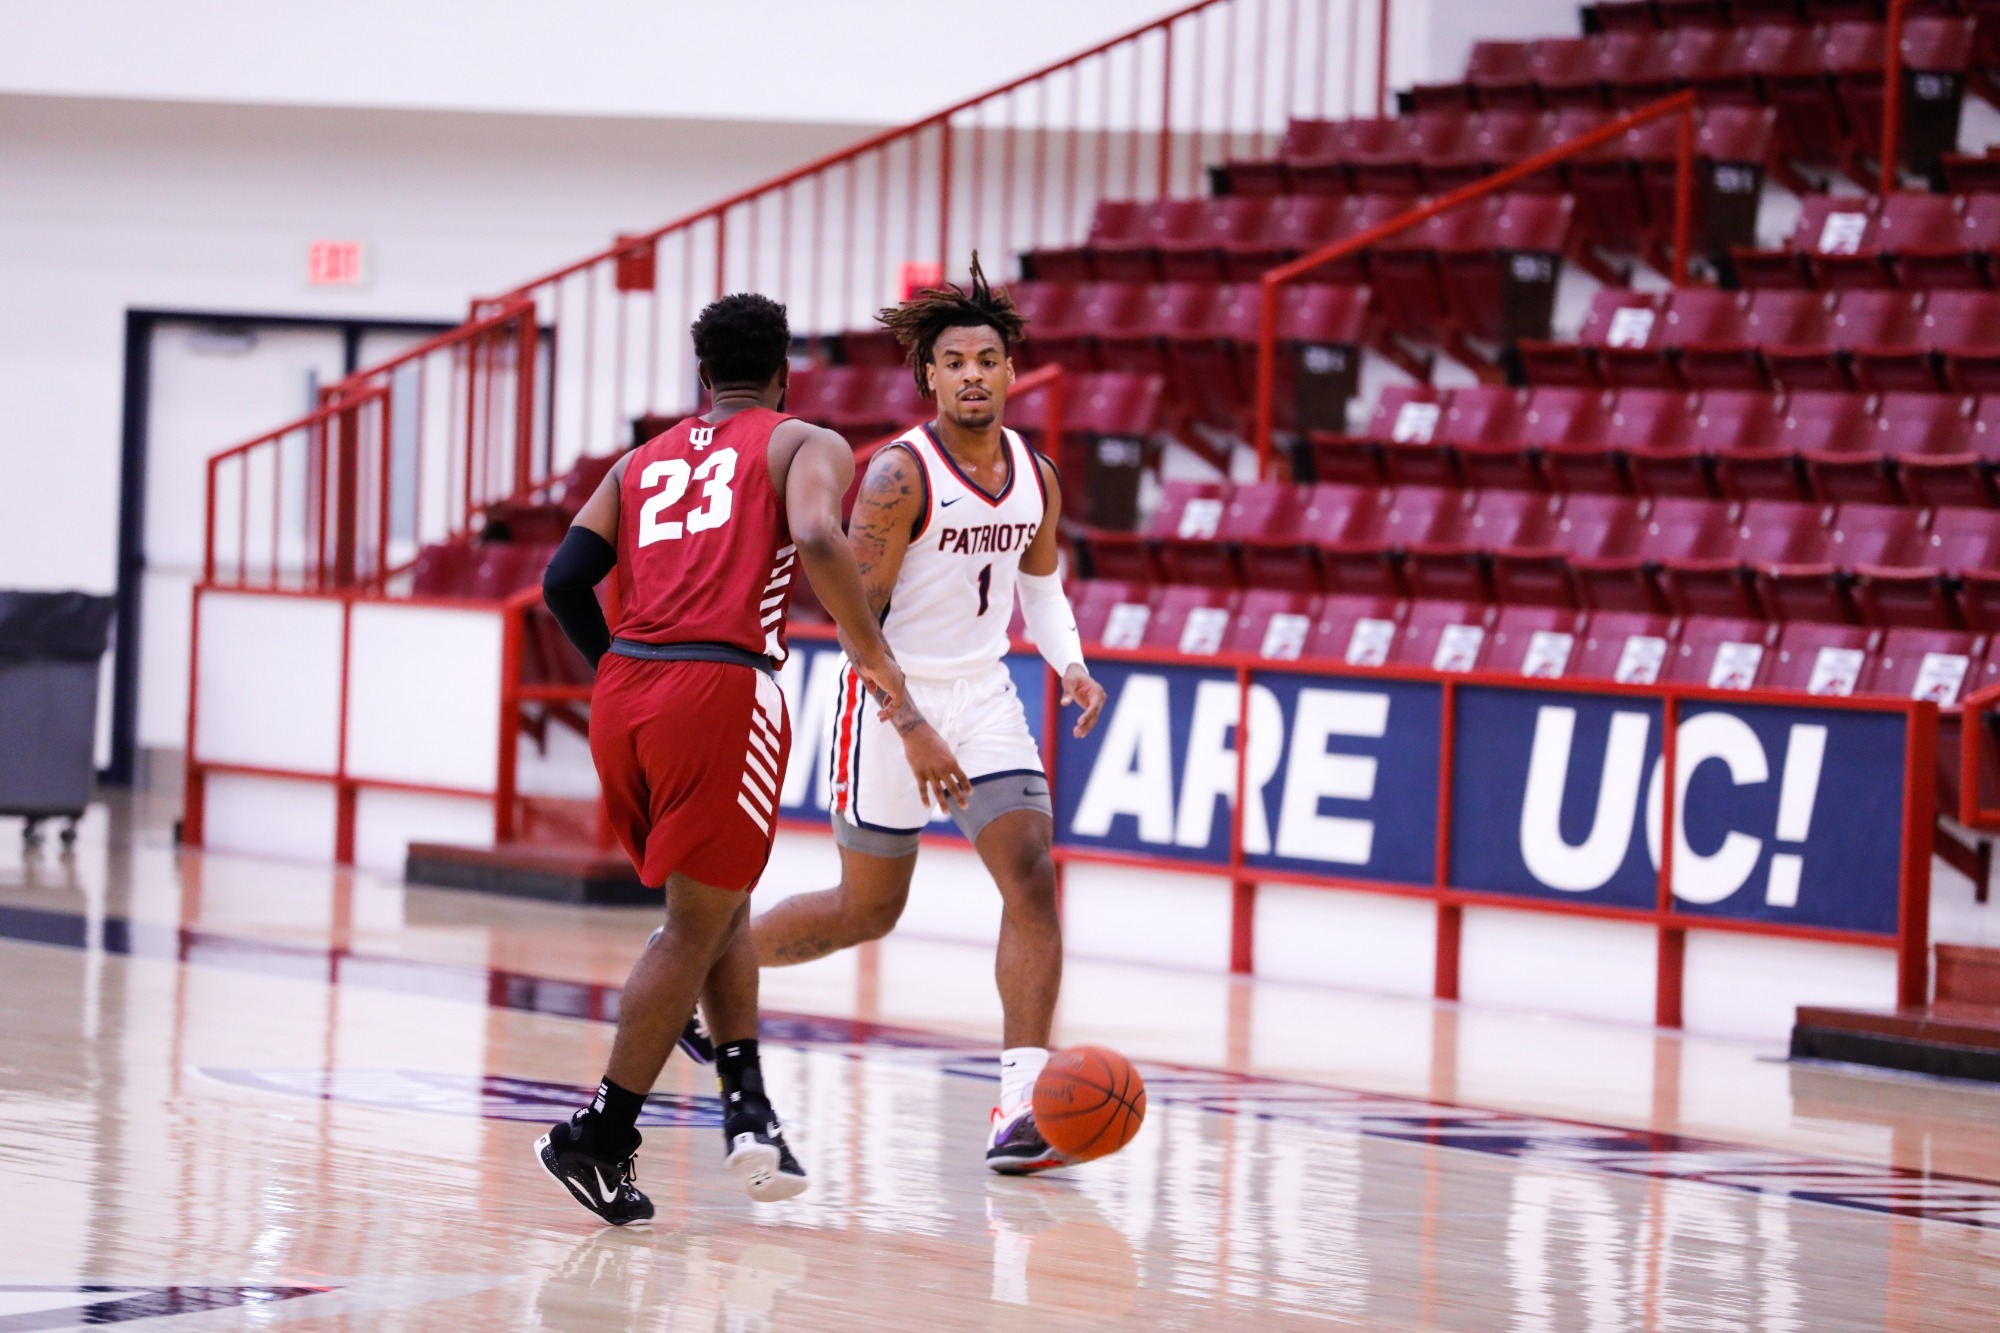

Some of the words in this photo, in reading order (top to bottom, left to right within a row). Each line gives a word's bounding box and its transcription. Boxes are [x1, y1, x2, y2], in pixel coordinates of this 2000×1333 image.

[638, 447, 738, 548] 23
[938, 523, 1036, 555] PATRIOTS
[976, 563, 993, 618] 1
[1071, 673, 1391, 866] ARE
[1519, 705, 1828, 909] UC!
